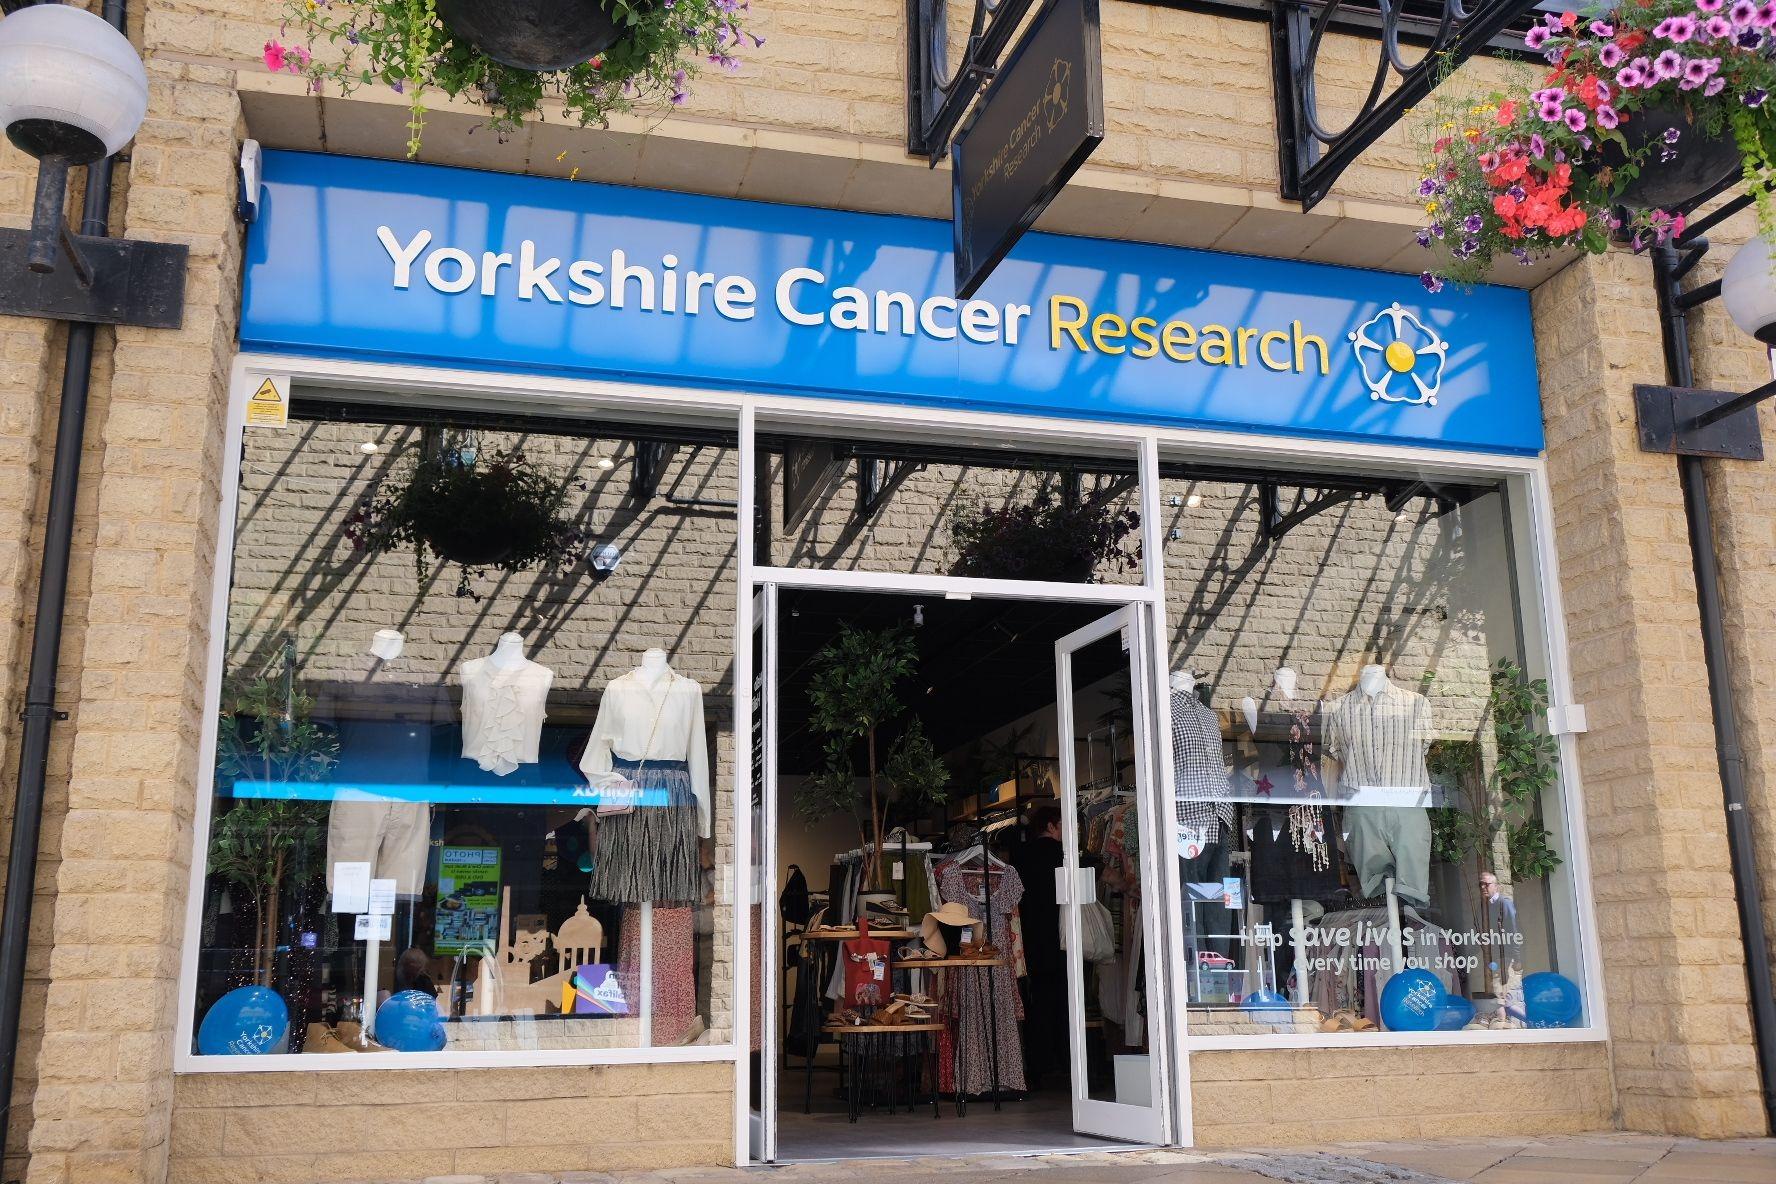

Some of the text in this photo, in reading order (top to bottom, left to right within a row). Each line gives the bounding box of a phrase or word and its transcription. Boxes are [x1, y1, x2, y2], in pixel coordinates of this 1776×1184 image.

[1009, 97, 1041, 149] Cancer
[1004, 124, 1041, 183] Research
[376, 225, 1330, 376] Yorkshire Cancer Research
[1240, 920, 1524, 951] Help save lives in Yorkshire
[1293, 952, 1479, 976] every time you shop
[1408, 987, 1433, 1009] Yorkshire
[1408, 993, 1428, 1010] Cancer
